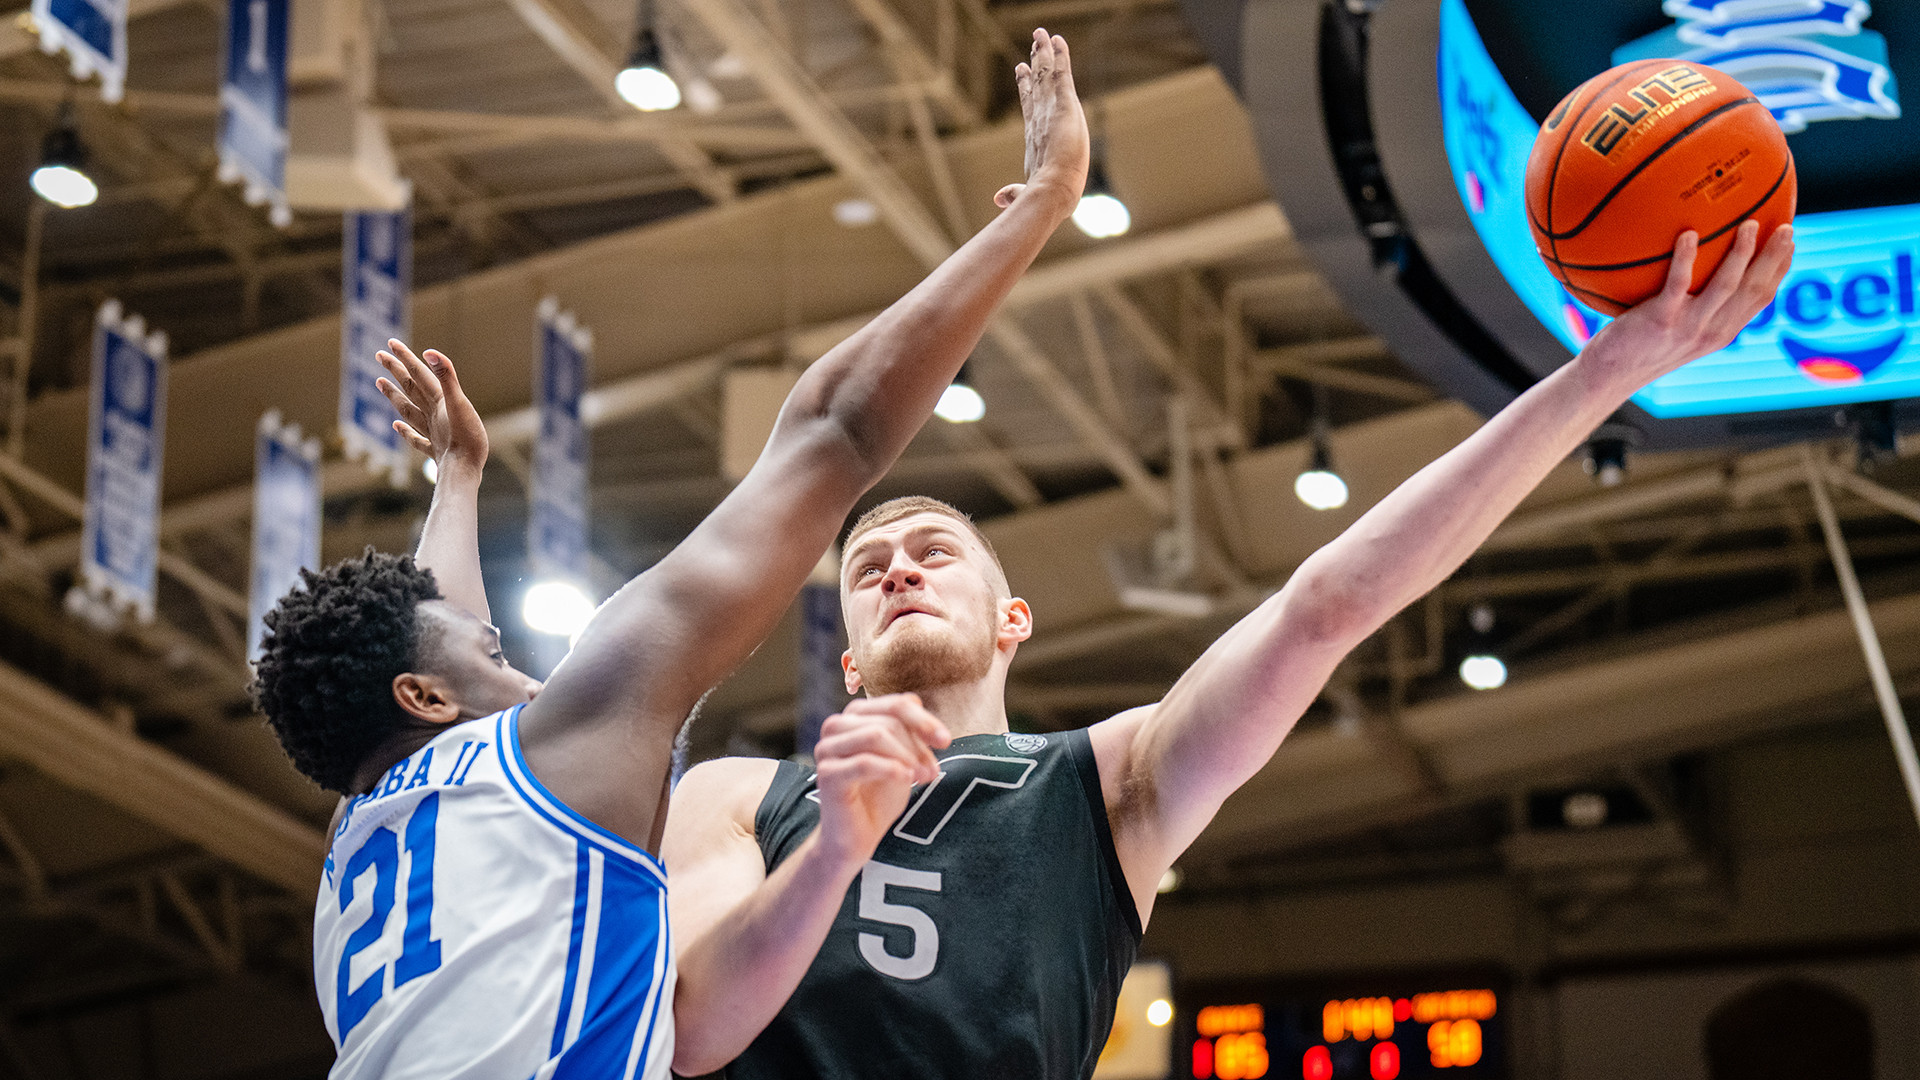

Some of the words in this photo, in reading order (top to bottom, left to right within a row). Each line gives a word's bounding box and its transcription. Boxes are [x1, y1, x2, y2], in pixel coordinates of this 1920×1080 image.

[1581, 64, 1711, 158] ELITE
[1609, 85, 1717, 166] AMPIONSHIP
[337, 790, 442, 1048] 21
[858, 860, 942, 980] 5
